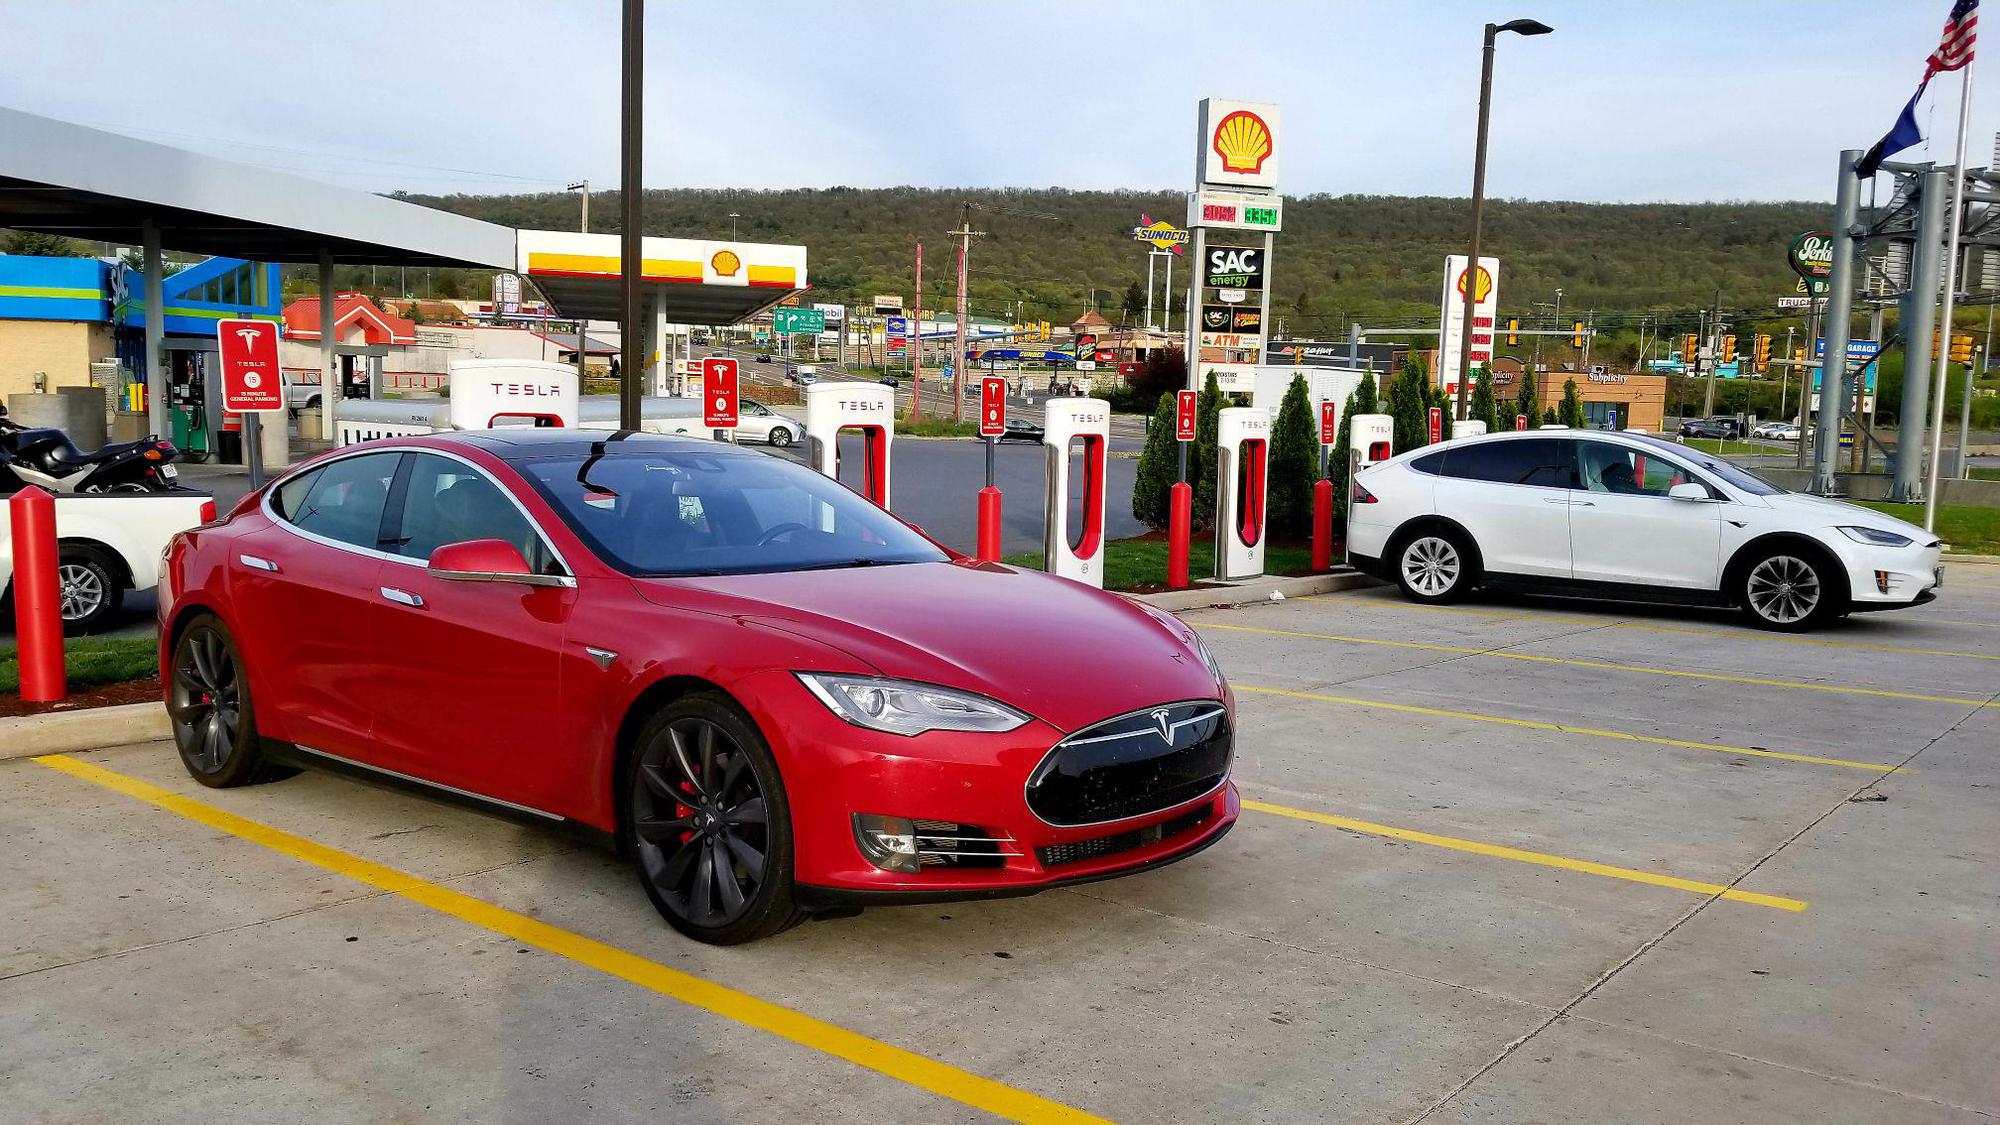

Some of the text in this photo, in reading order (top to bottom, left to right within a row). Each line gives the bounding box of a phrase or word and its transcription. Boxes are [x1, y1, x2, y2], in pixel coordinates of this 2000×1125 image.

[1141, 229, 1187, 241] SUNOCO
[1798, 236, 1833, 261] Perki
[1211, 249, 1257, 274] SAC
[1209, 276, 1249, 287] energy
[855, 306, 873, 316] GIFT
[1214, 335, 1240, 346] ATM
[1847, 344, 1876, 353] GARAGE
[248, 376, 258, 384] 15
[491, 383, 561, 396] TESLA
[838, 401, 884, 411] TESLA
[1071, 414, 1104, 423] TESLA
[1241, 421, 1267, 429] TESLA
